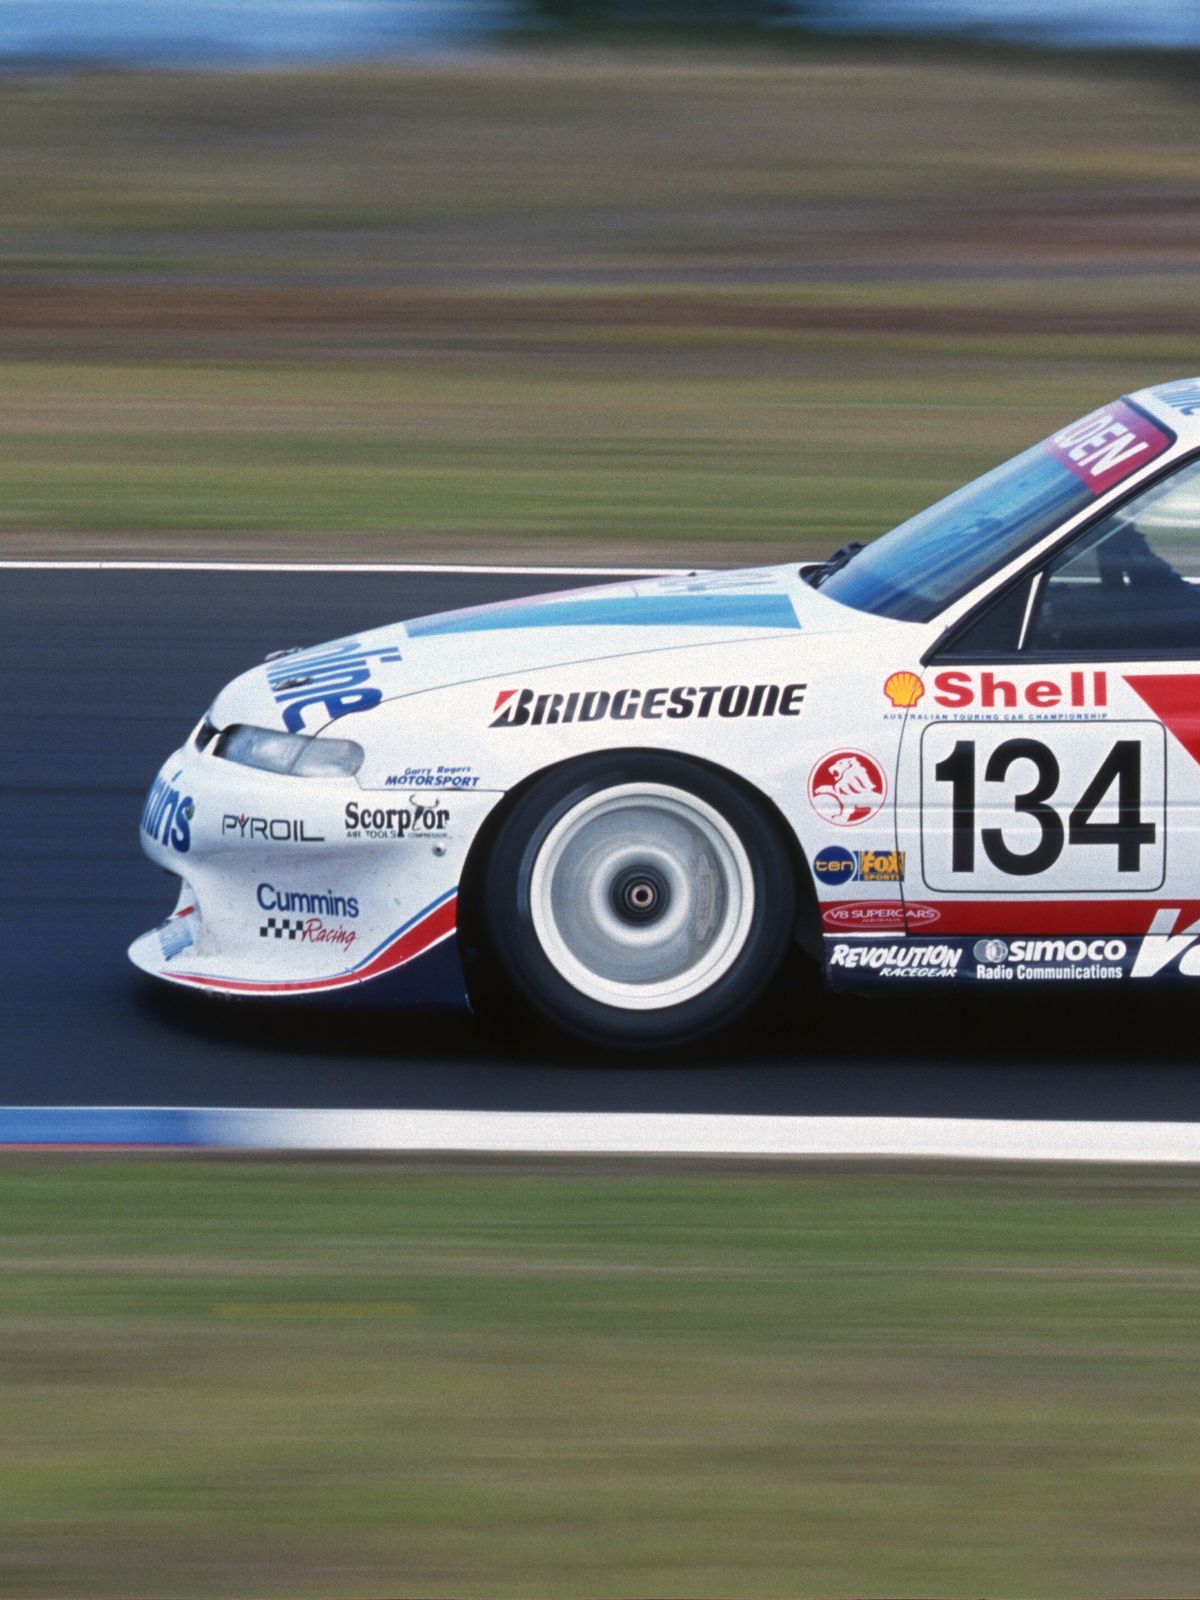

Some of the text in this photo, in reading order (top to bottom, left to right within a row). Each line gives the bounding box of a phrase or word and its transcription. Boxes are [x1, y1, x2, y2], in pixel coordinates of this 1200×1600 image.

[934, 671, 1107, 708] Shell
[487, 683, 808, 728] BRIDGESTONE
[954, 713, 1000, 721] TOURING
[1004, 713, 1025, 721] CAR
[385, 775, 480, 787] MOTORSPORT
[935, 738, 1156, 876] 134
[222, 814, 325, 842] PYROIL
[256, 883, 360, 918] Cummins
[830, 908, 936, 920] V8 SUPERCARS
[302, 917, 357, 953] Racing
[879, 967, 958, 978] RACEGEAR
[976, 964, 1123, 980] Radio Communications
